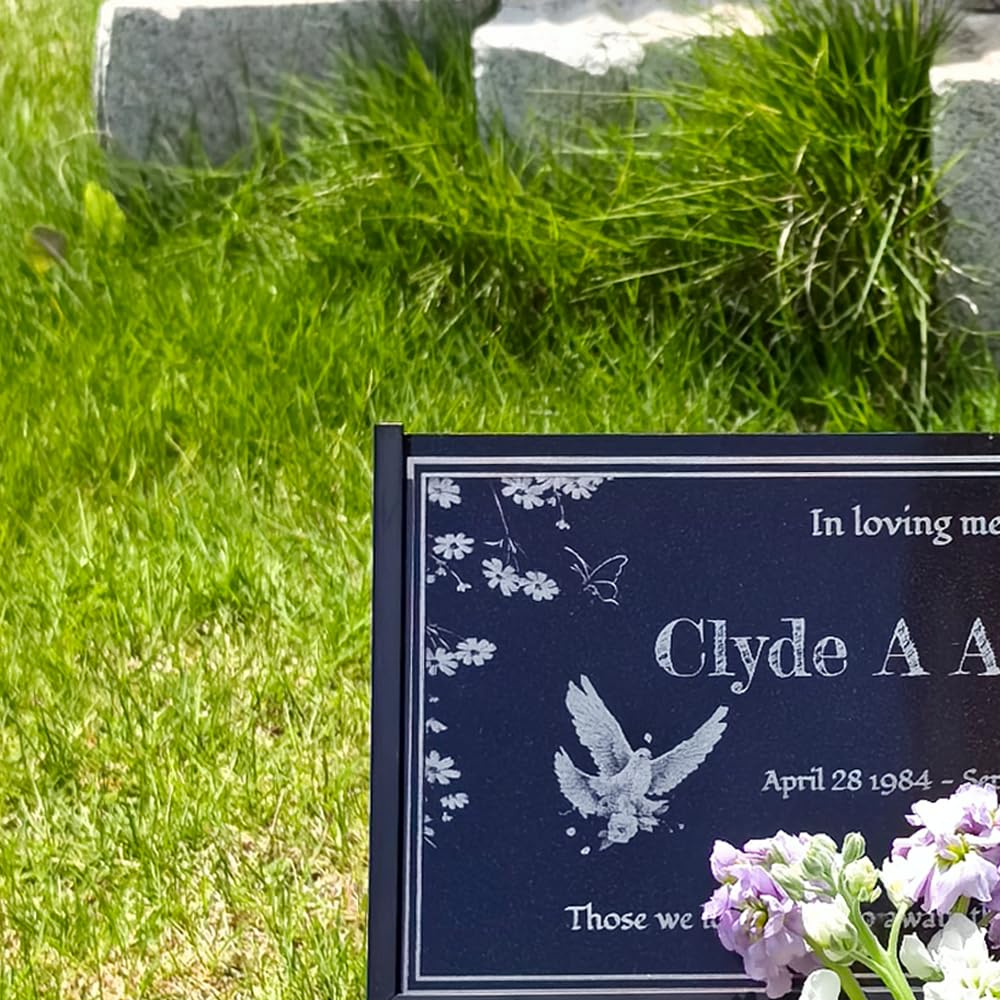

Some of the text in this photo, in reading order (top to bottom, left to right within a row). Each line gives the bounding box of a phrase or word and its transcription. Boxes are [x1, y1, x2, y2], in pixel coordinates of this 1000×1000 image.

[810, 508, 845, 537] In
[853, 505, 953, 545] loving
[654, 617, 848, 694] Clyde
[872, 617, 931, 677] A
[761, 766, 826, 799] April
[831, 769, 863, 791] 28
[868, 769, 933, 796] 1984
[564, 901, 648, 931] Those
[654, 912, 693, 930] we
